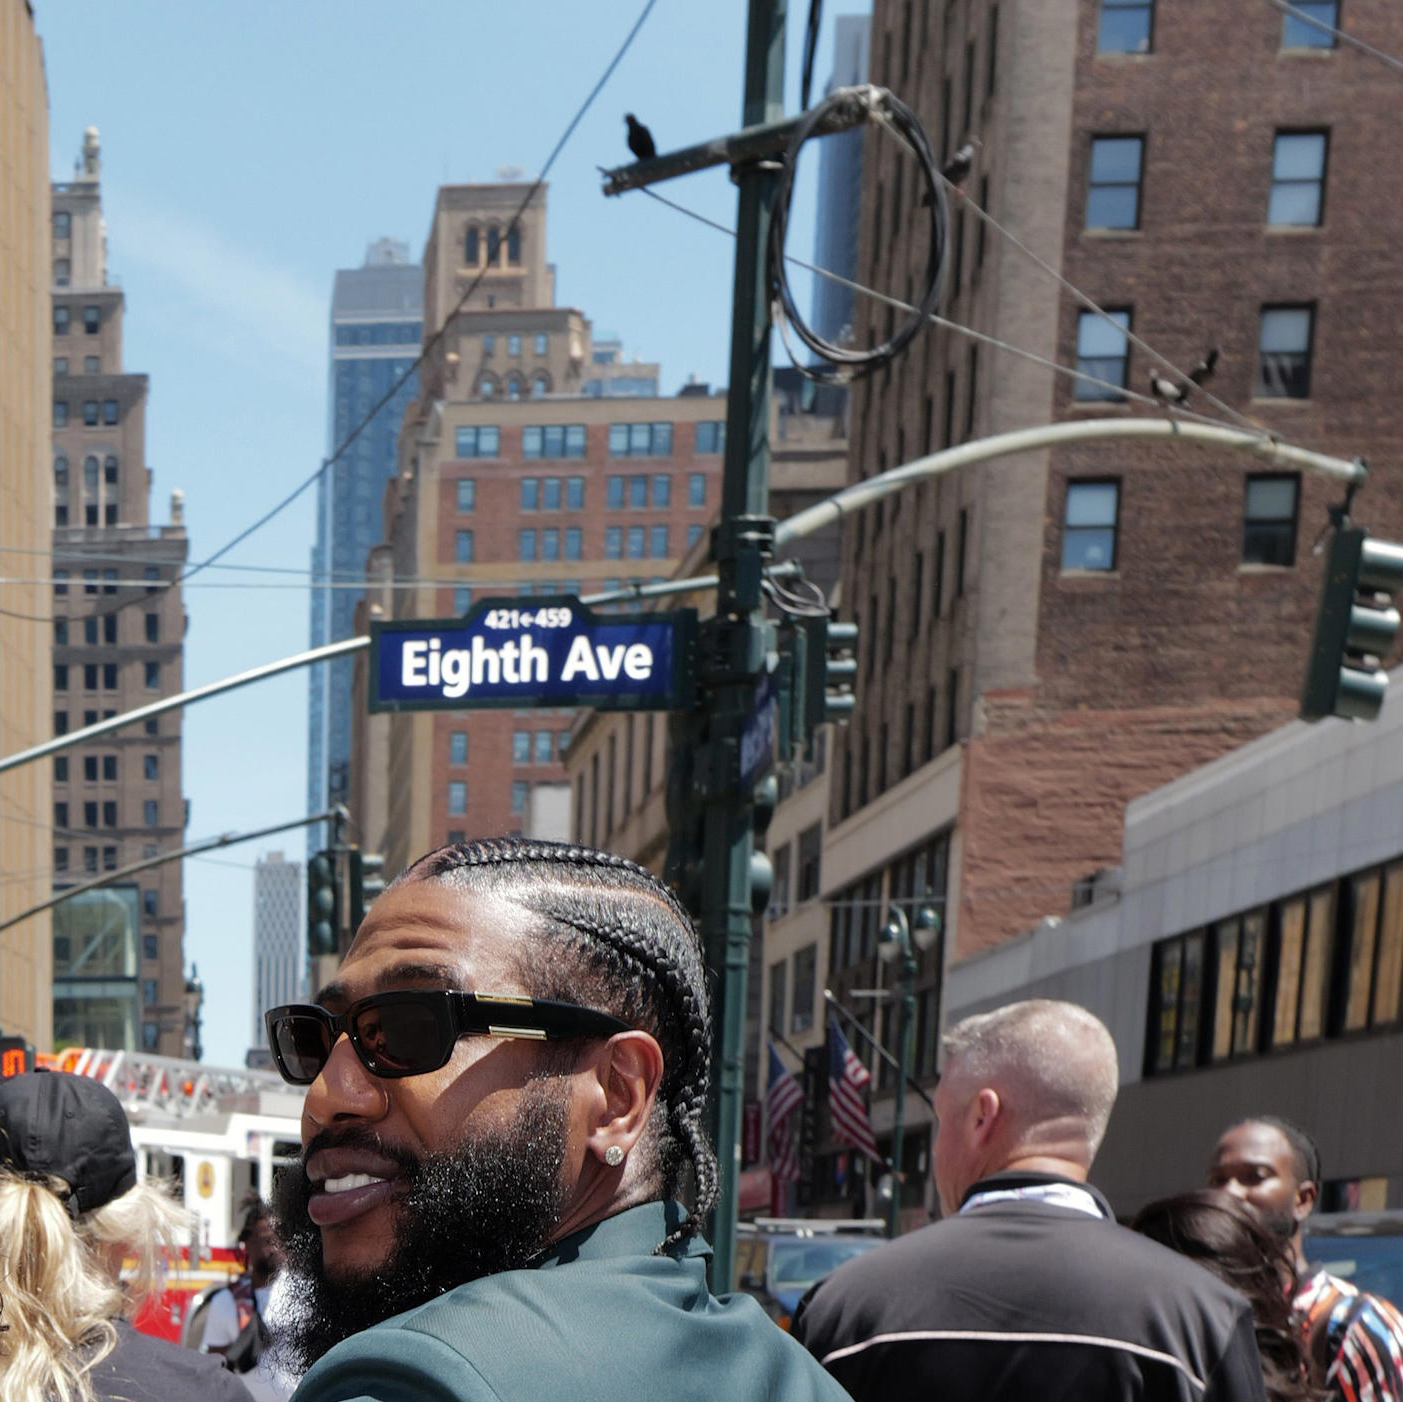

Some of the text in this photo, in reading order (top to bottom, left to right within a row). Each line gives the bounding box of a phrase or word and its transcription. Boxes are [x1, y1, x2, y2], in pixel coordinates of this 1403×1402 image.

[484, 607, 572, 629] 421 459
[401, 634, 653, 698] Eighth Ave
